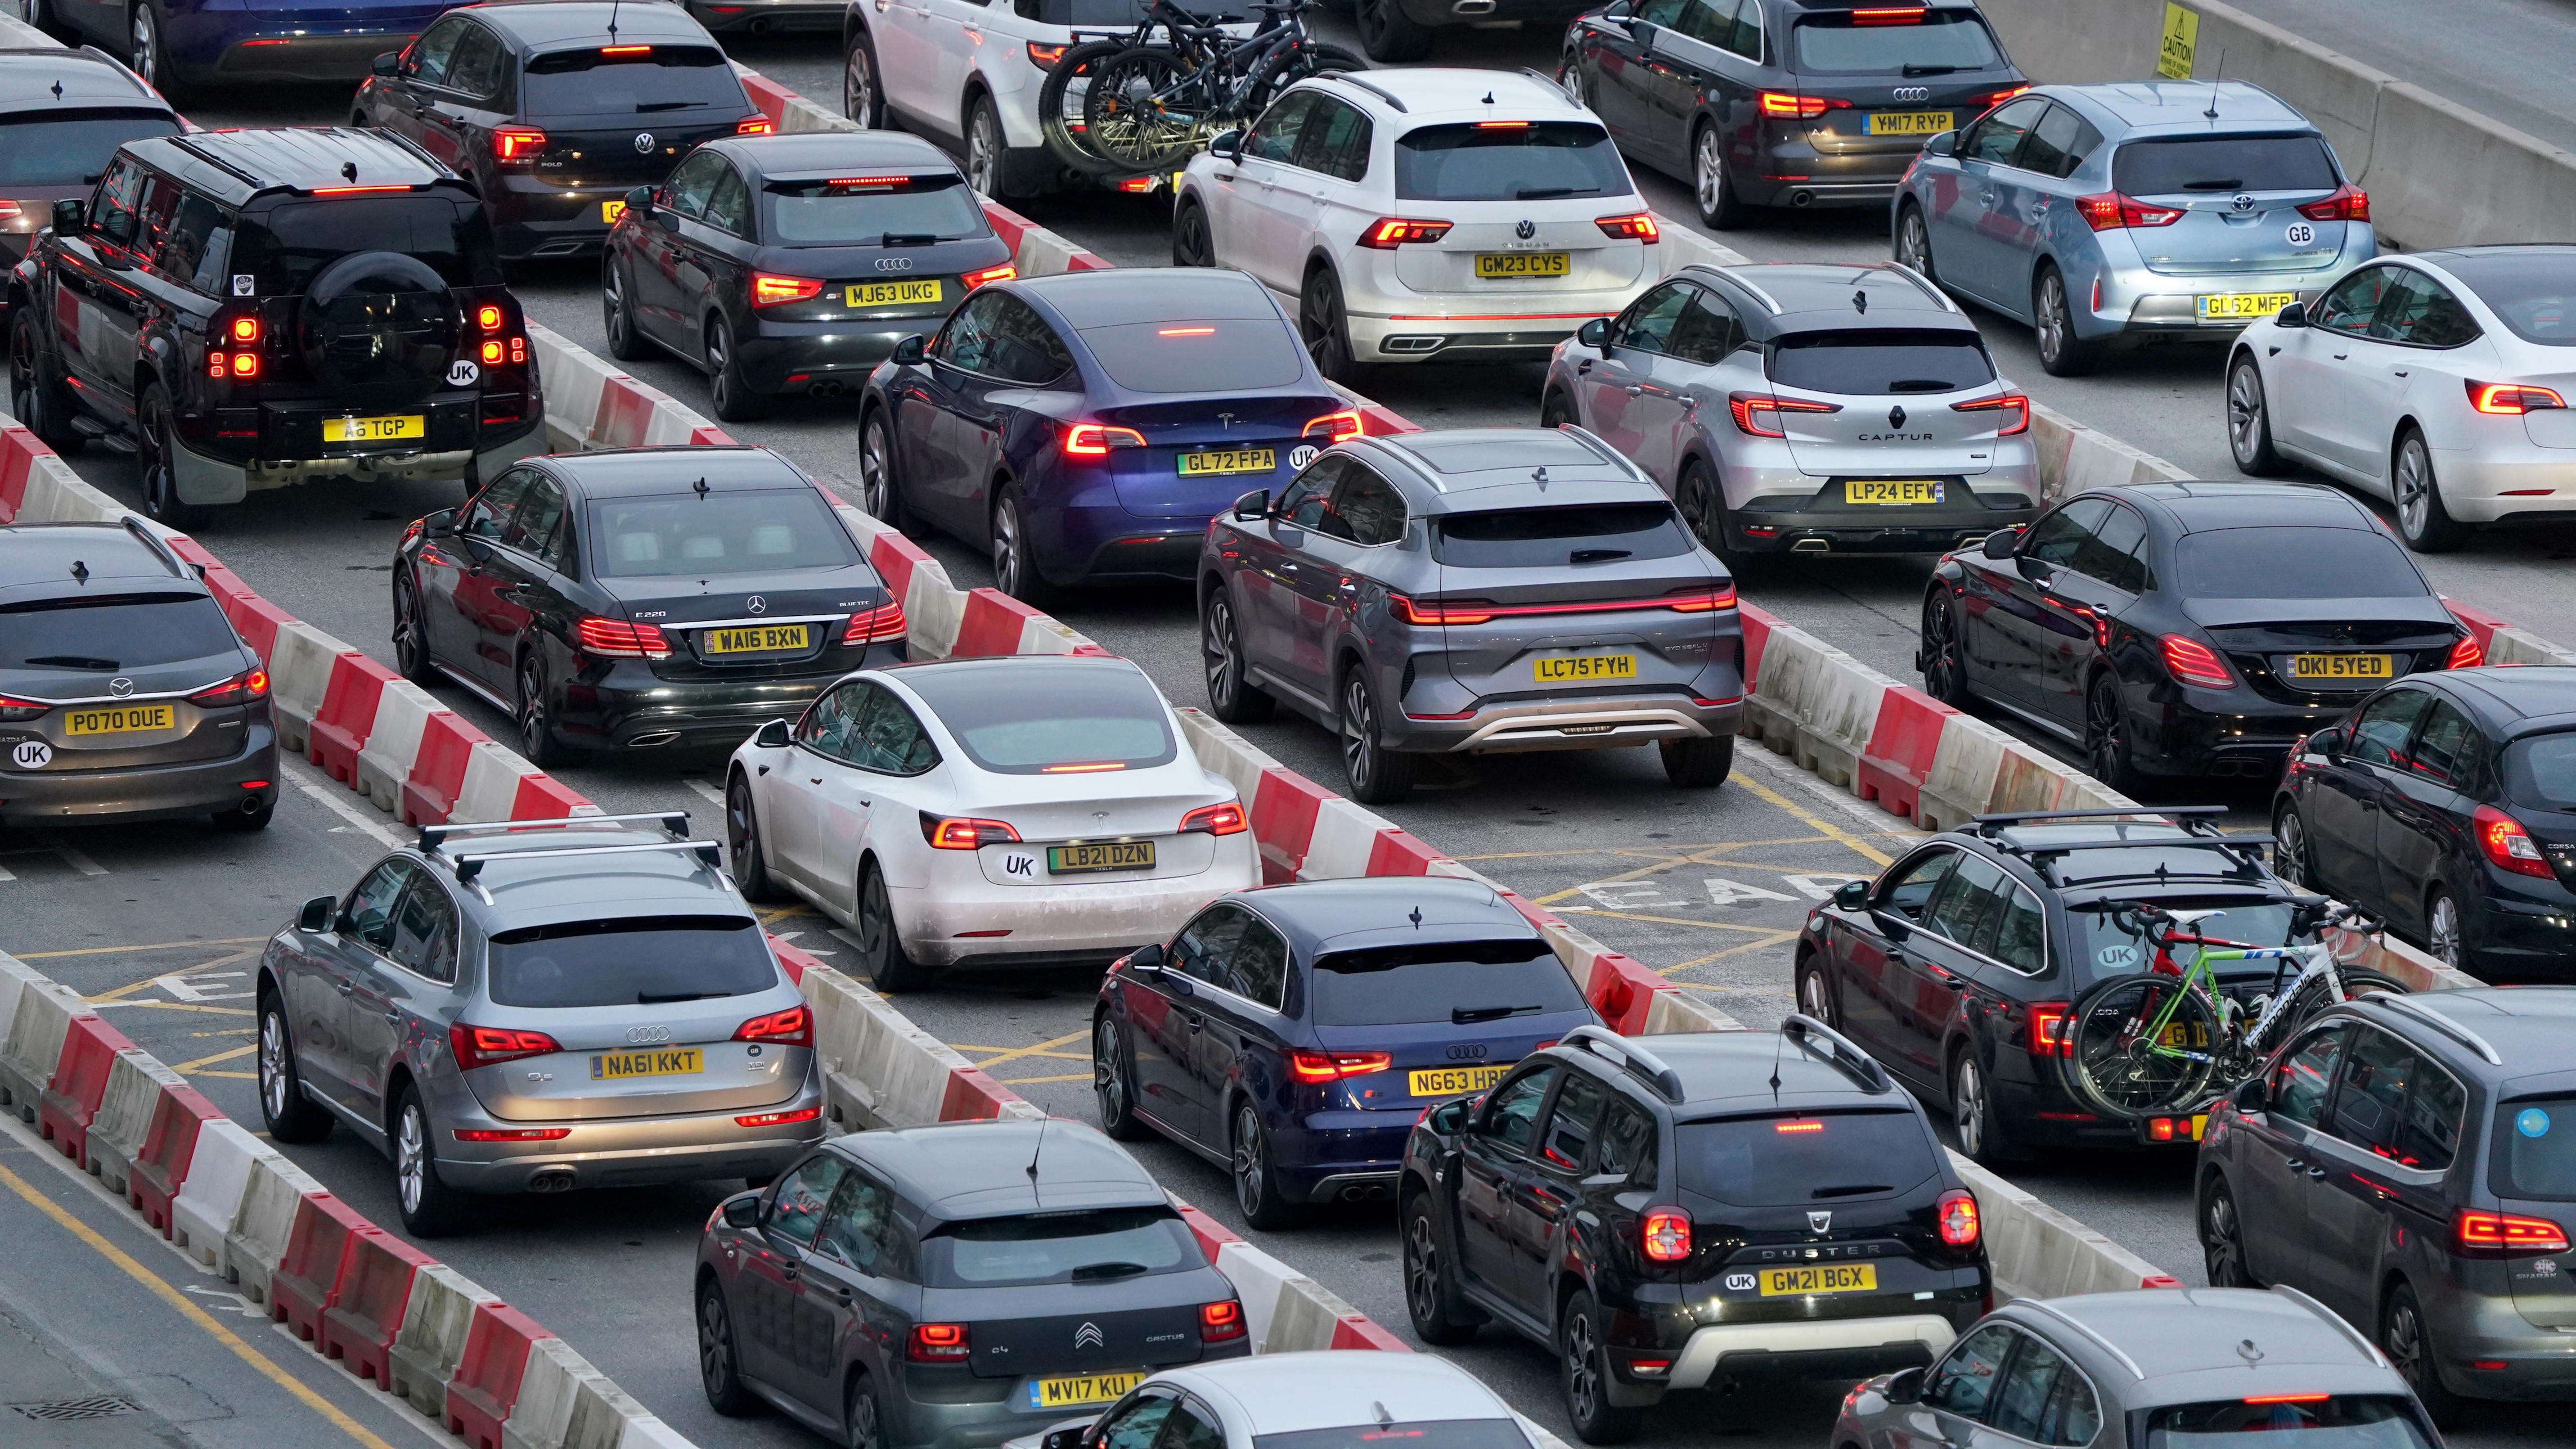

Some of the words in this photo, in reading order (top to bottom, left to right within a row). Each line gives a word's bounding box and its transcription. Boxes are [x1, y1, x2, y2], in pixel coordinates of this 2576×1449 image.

[2164, 36, 2192, 61] CAUTION
[1877, 115, 1912, 130] YM17
[1917, 112, 1948, 129] RYP
[2290, 227, 2310, 242] GB
[1483, 256, 1526, 272] GM23
[1531, 256, 1563, 271] CYS
[853, 286, 896, 303] MJ63
[901, 284, 933, 300] UKG
[2210, 298, 2251, 313] GL62
[450, 366, 474, 380] UK
[345, 421, 366, 437] A6
[371, 420, 404, 436] TGP
[1188, 453, 1234, 470] GL72
[1239, 451, 1273, 467] FPA
[1292, 449, 1314, 466] UK
[1853, 484, 1898, 499] LP24
[1903, 484, 1936, 498] EFW
[721, 631, 761, 650] WA16
[766, 628, 801, 647] BXN
[1541, 659, 1589, 677] LC75
[1594, 656, 1629, 674] FYH
[2333, 657, 2381, 674] 5YED
[74, 713, 124, 731] PO70
[129, 709, 165, 727] OUE
[19, 746, 46, 763] UK
[1065, 848, 1107, 866] LB21
[1112, 845, 1148, 863] DZN
[1007, 855, 1034, 876] UK
[2103, 948, 2133, 964] UK
[2251, 974, 2310, 1048] cannondale
[609, 1055, 651, 1075] NA61
[658, 1052, 695, 1072] KKT
[1417, 1072, 1468, 1091] NG63
[1762, 1245, 1879, 1259] DUSTER
[1729, 1276, 1752, 1288] UK
[1773, 1272, 1818, 1291] GM21
[1824, 1268, 1864, 1288] BGX
[1048, 1380, 1093, 1401] MV17
